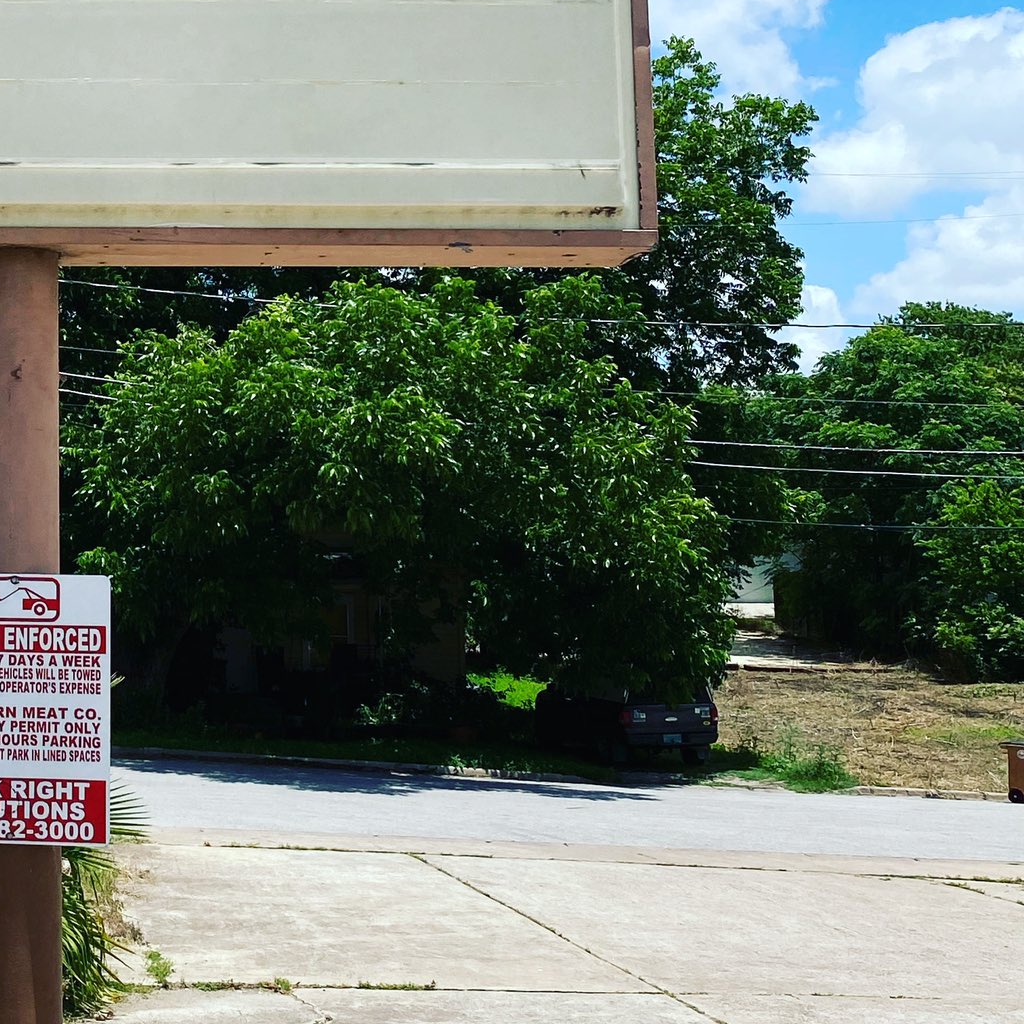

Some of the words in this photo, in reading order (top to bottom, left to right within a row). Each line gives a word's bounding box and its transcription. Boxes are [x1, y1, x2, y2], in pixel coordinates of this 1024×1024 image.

[3, 627, 102, 652] ENFORCED
[8, 654, 45, 667] DAYS
[48, 655, 58, 667] A
[61, 655, 102, 668] WEEK
[35, 668, 56, 681] WILL
[58, 669, 69, 681] BE
[71, 669, 101, 682] TOWED
[0, 681, 57, 694] OPERATOR'S
[59, 682, 102, 695] EXPENSE
[22, 707, 69, 720] MEAT
[73, 708, 102, 720] CO.
[10, 721, 61, 734] PERMIT
[64, 722, 101, 735] ONLY
[42, 735, 102, 749] PARKING
[7, 749, 30, 761] PARK
[31, 749, 41, 762] IN
[42, 750, 67, 762] LINED
[69, 750, 102, 763] SPACES
[10, 780, 91, 801] RIGHT
